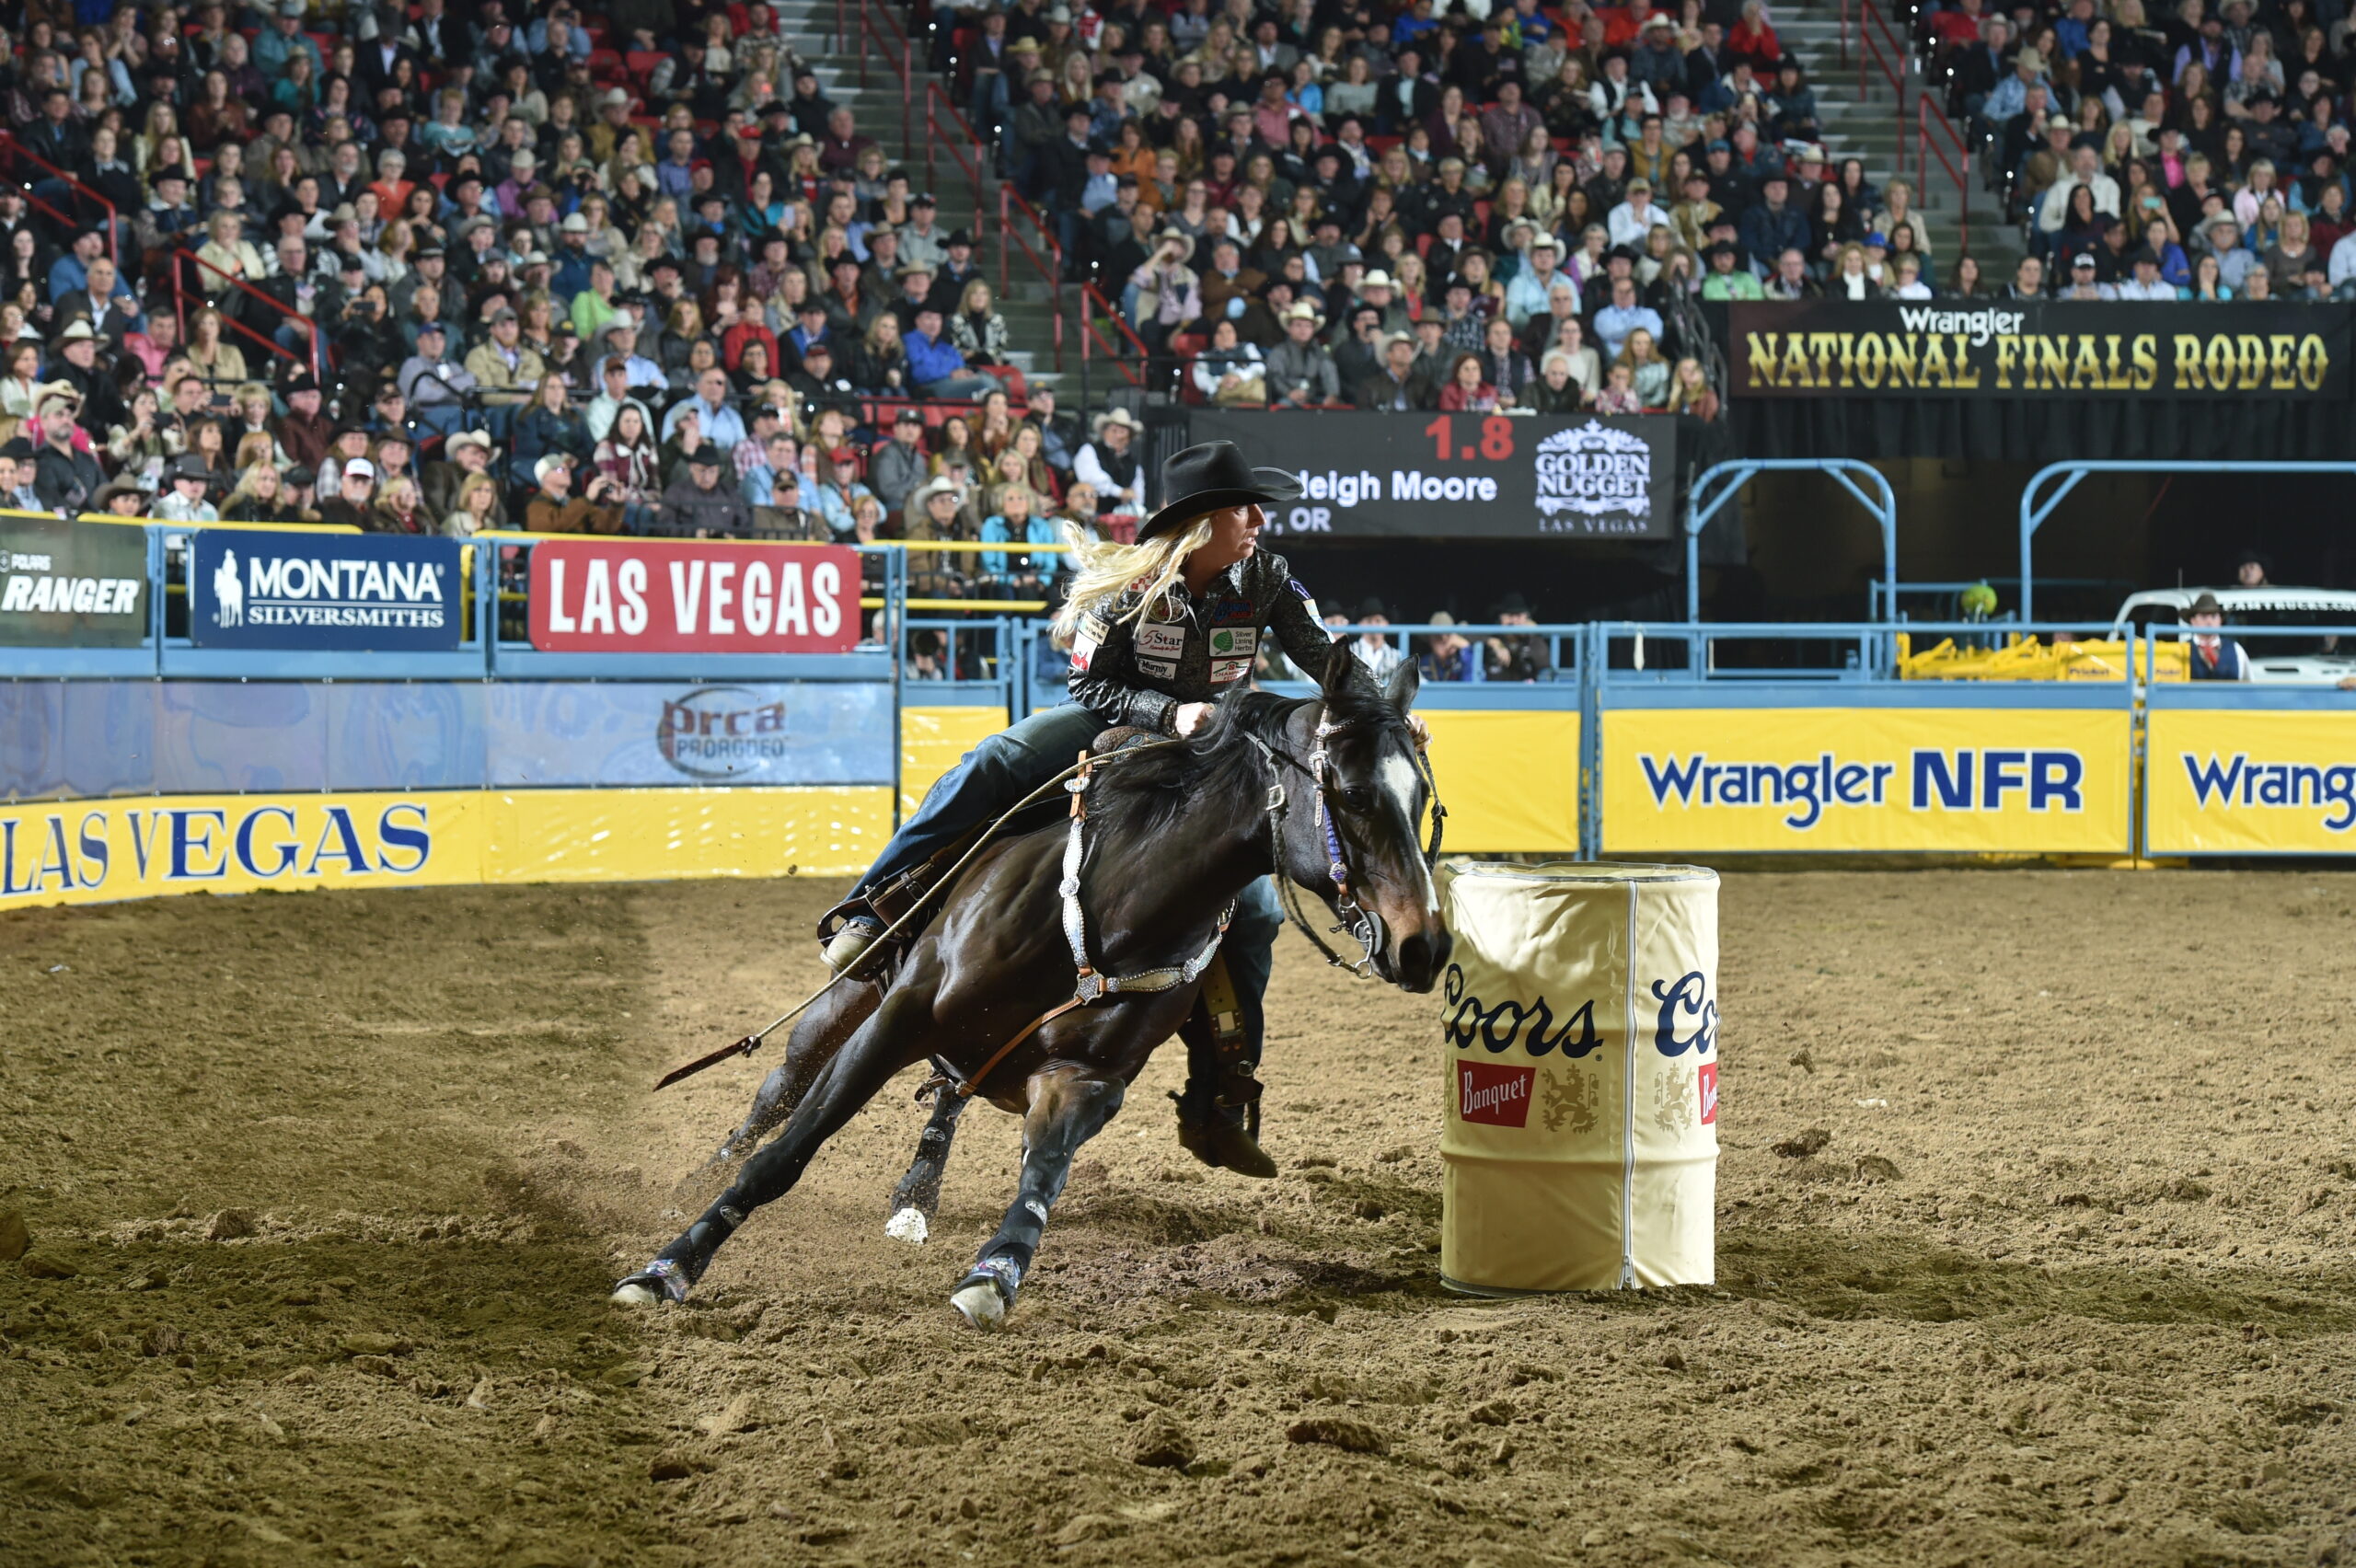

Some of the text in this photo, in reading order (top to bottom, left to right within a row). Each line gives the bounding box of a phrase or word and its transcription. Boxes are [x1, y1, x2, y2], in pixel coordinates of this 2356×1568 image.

[1900, 306, 2024, 347] Wrangler
[1747, 331, 2328, 391] NATIONAL FINALS RODEO
[1425, 414, 1514, 460] 1.8
[1535, 453, 1650, 476] GOLDEN
[1536, 473, 1650, 496] NUGGET
[1296, 470, 1498, 507] leigh Moore
[1289, 506, 1332, 532] OR
[2, 575, 140, 614] RANGER
[248, 557, 443, 603] MONTANA
[549, 558, 841, 637] LAS VEGAS
[248, 605, 445, 628] SILVERSMITHS
[1138, 629, 1183, 646] 5 Star
[664, 700, 785, 761] prca
[1639, 750, 2083, 828] Wrangler NFR
[0, 804, 430, 896] LAS VEGAS
[1440, 963, 1604, 1058] Coors
[1462, 1070, 1528, 1115] Banquet
